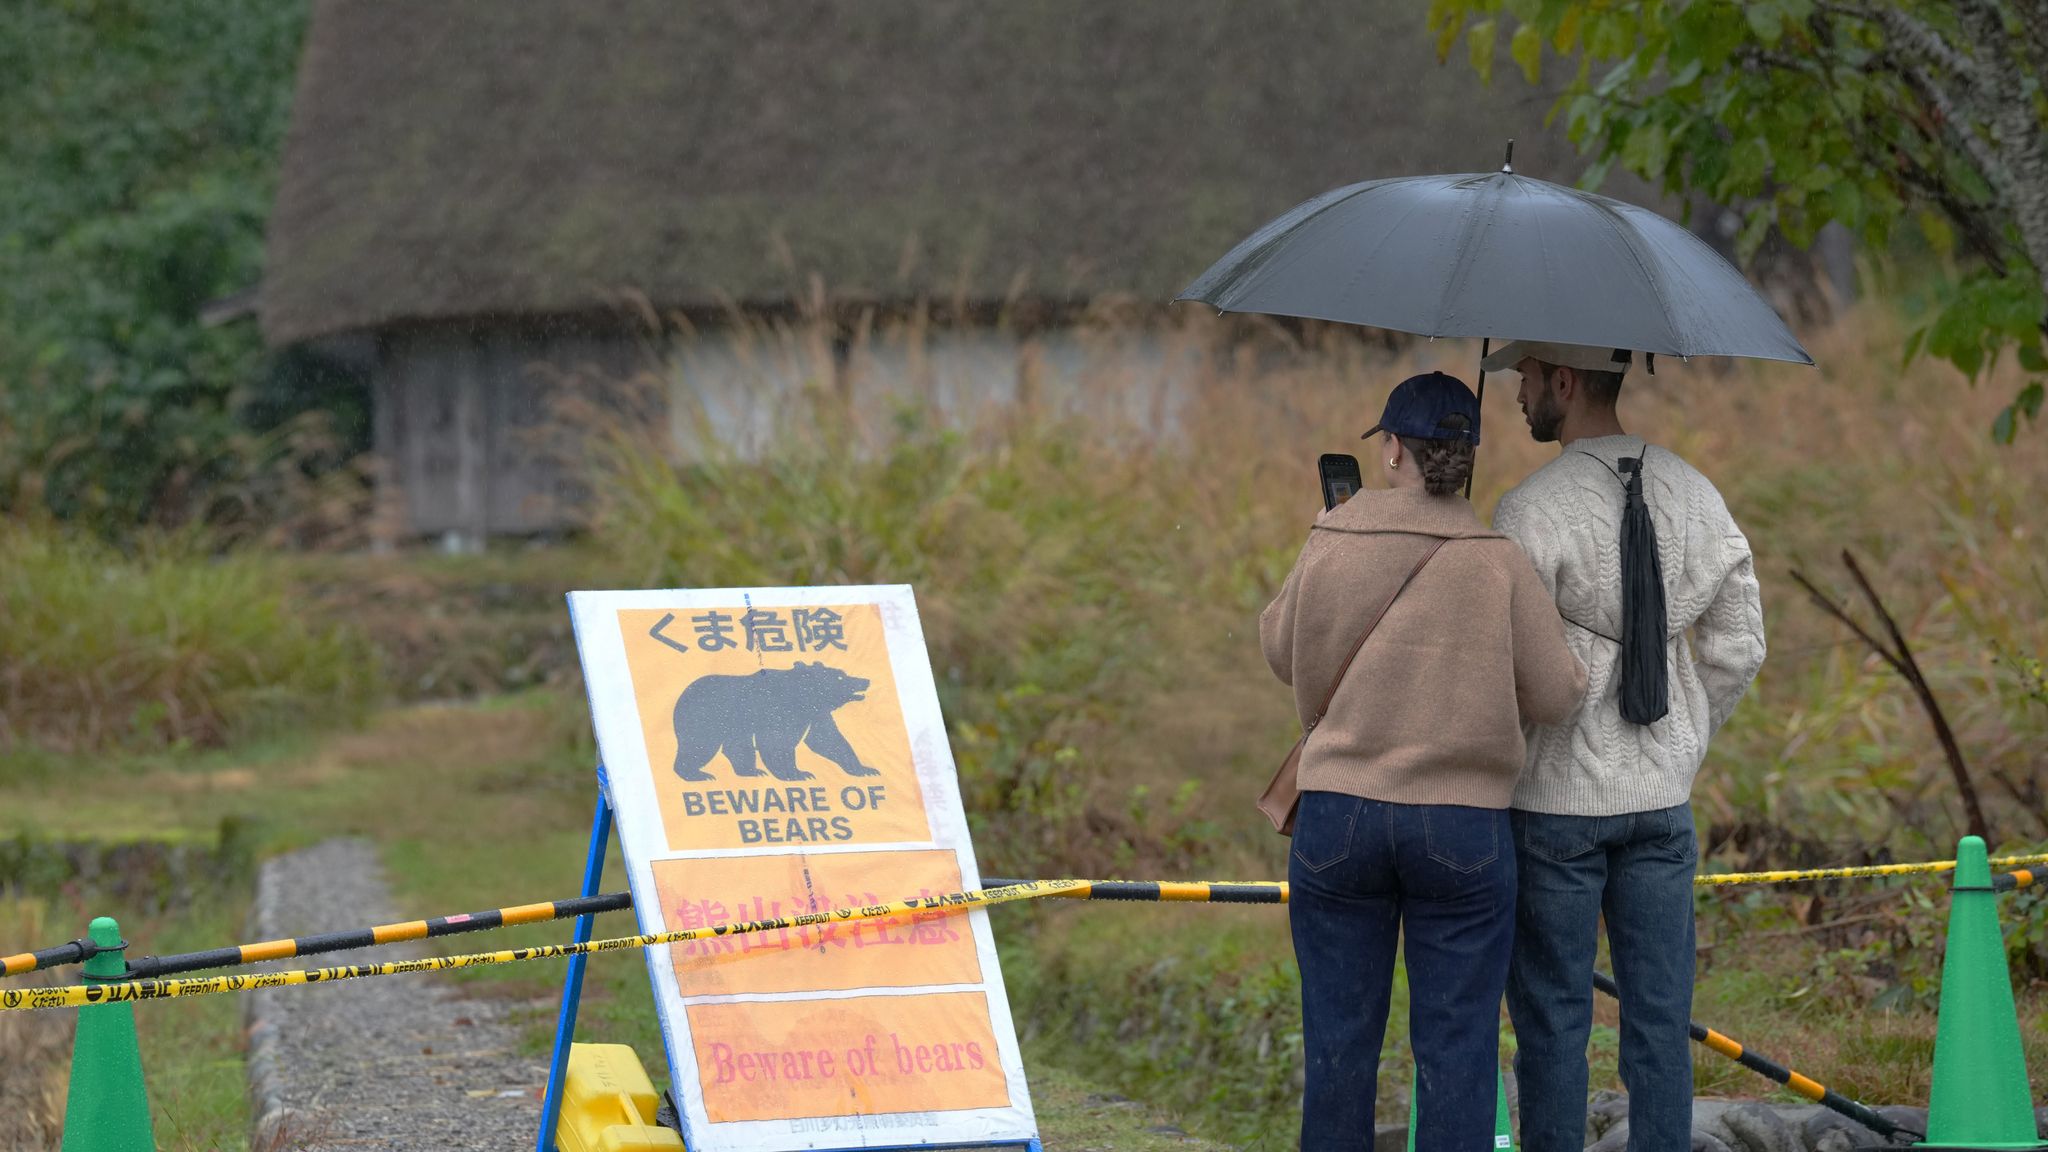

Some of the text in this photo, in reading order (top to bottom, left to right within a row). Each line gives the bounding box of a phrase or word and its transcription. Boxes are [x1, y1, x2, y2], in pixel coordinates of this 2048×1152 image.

[649, 608, 848, 653] くま危険
[682, 785, 886, 817] BEWARE OF
[738, 816, 854, 843] BEARS
[32, 996, 66, 1008] ください
[709, 1026, 984, 1084] Beware of bears
